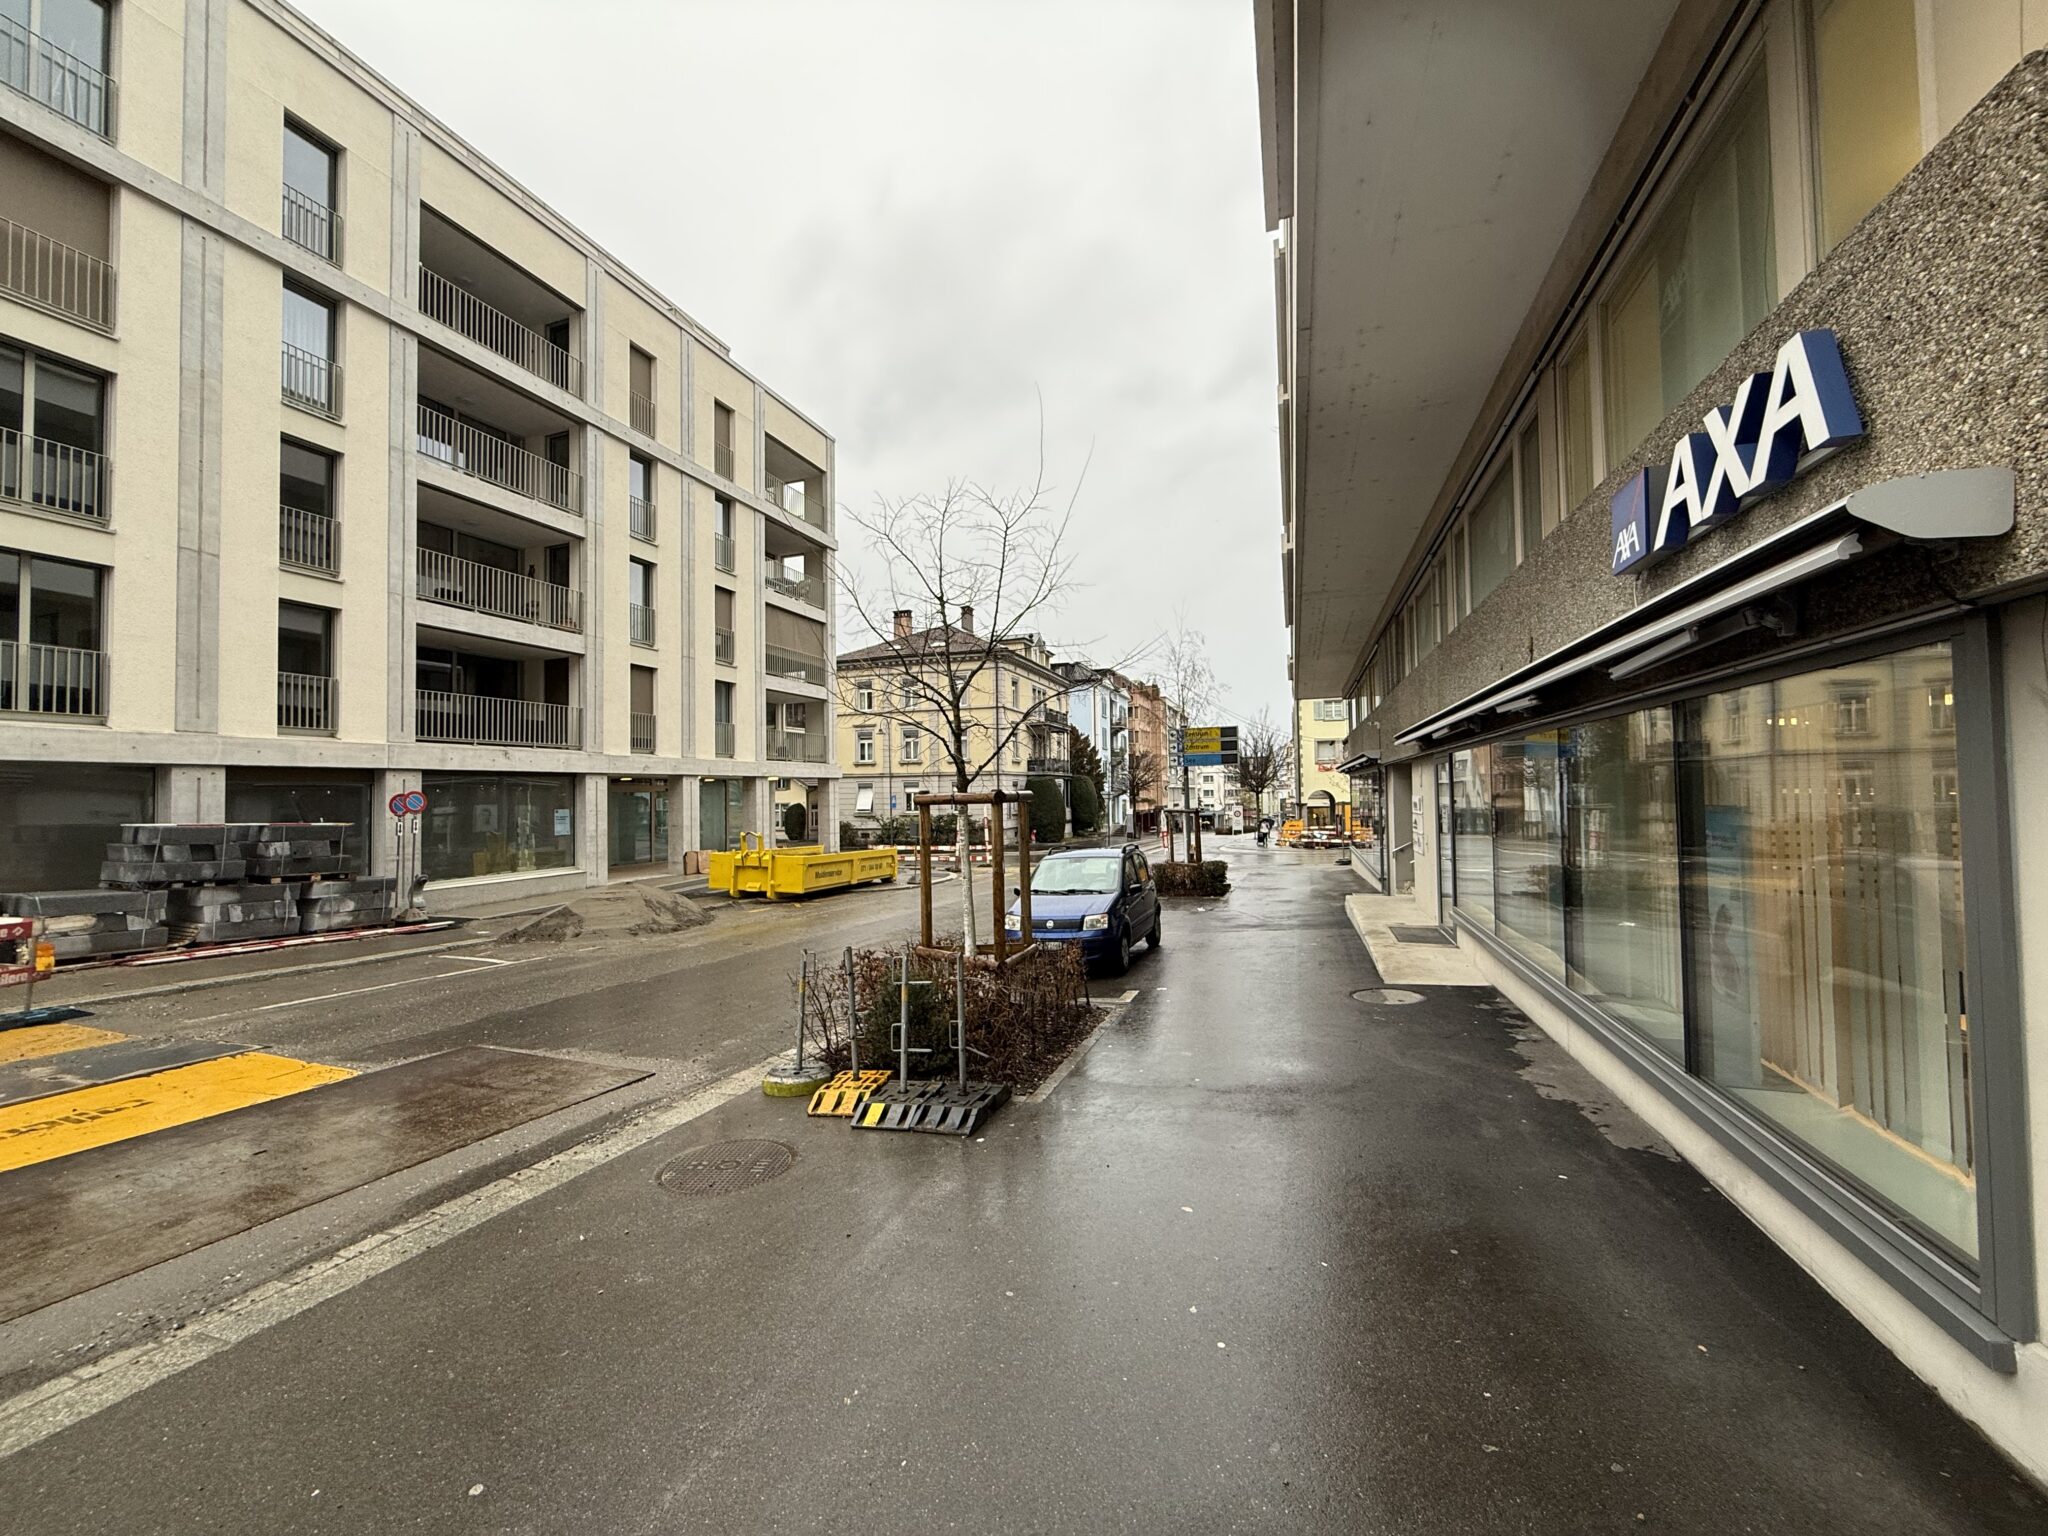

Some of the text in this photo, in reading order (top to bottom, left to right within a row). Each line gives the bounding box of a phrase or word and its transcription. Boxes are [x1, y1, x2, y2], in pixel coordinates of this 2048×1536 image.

[1653, 332, 1831, 552] AXA
[1612, 521, 1640, 568] AXA
[1185, 742, 1210, 751] Zentrum
